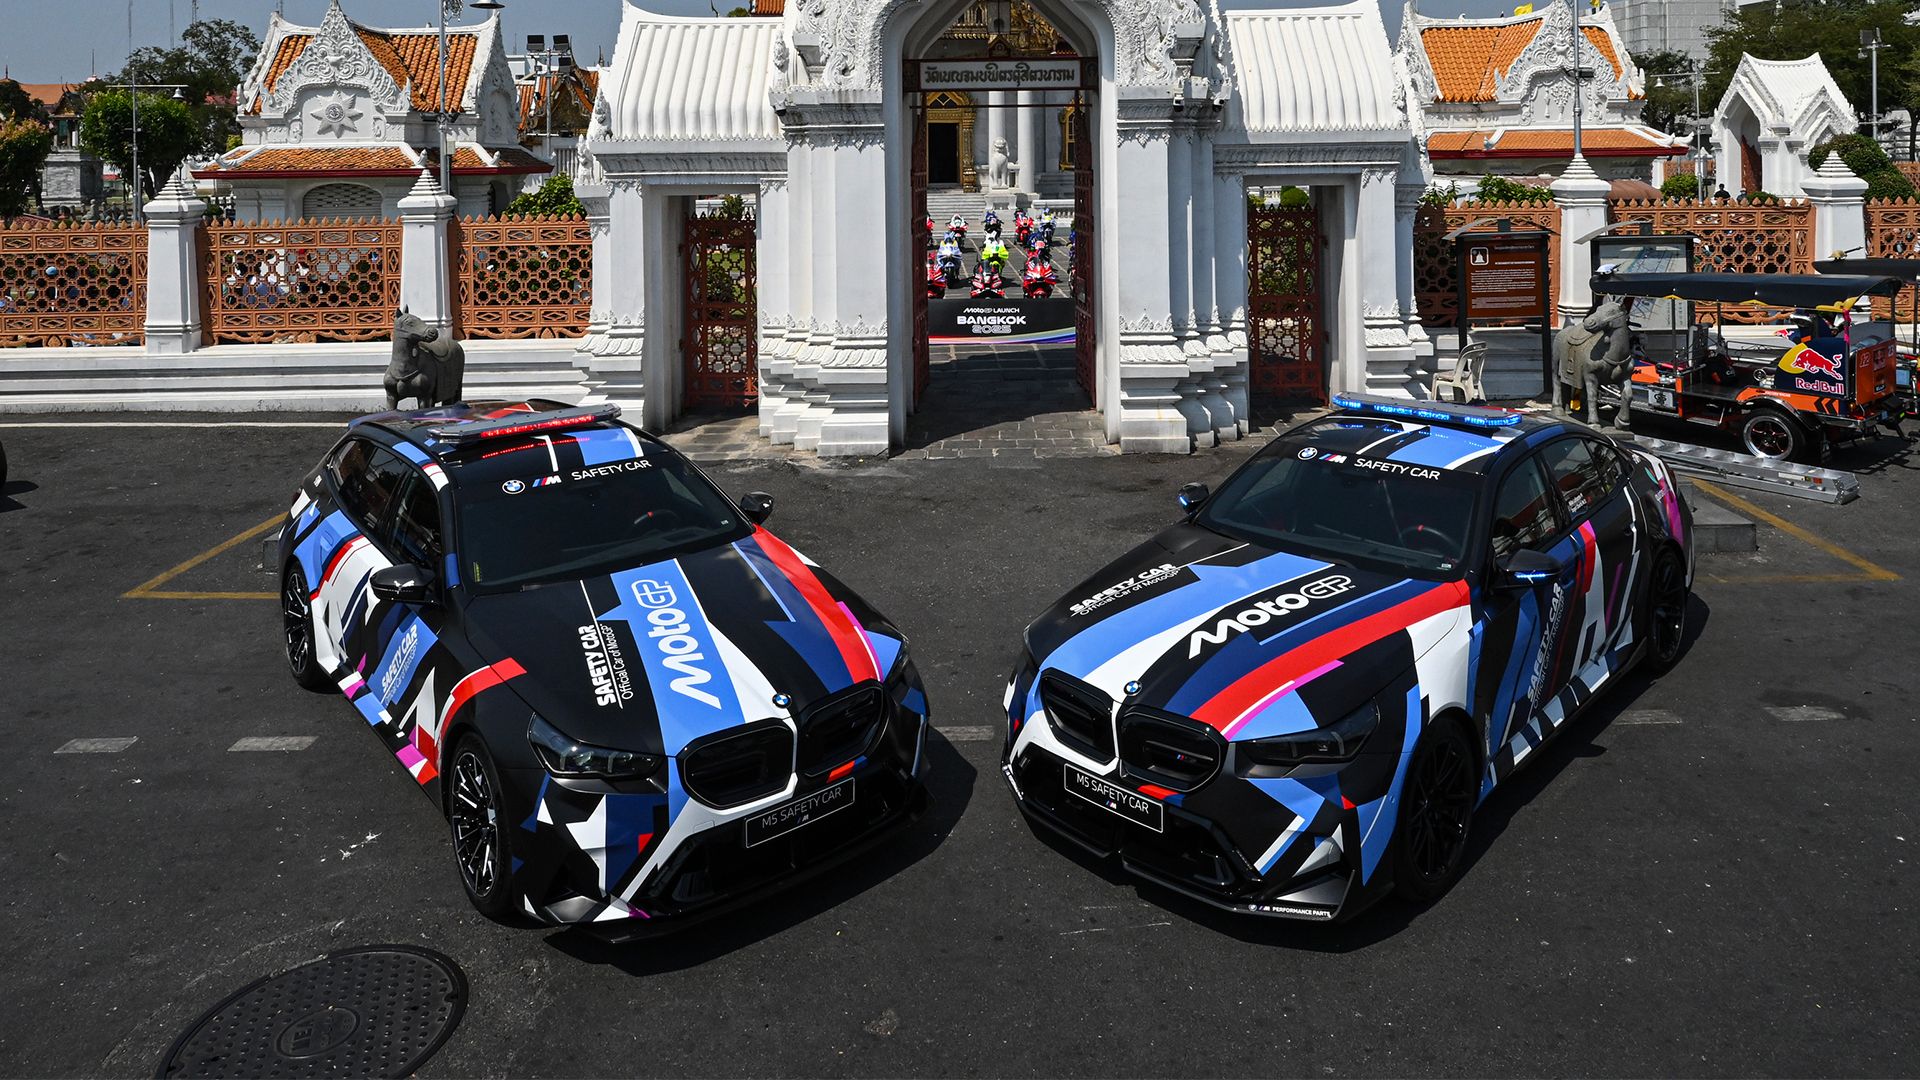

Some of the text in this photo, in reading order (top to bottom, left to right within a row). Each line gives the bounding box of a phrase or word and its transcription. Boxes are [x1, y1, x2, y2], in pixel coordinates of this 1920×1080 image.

[957, 315, 1027, 325] BANGKOK
[971, 324, 1012, 334] 2025
[1795, 377, 1845, 396] Red Bull
[570, 464, 624, 481] SAFETY
[625, 459, 652, 472] CAR
[1353, 458, 1410, 475] SAFETY
[1409, 467, 1441, 481] CAR
[1069, 563, 1177, 612] SAFETY CAR
[1115, 588, 1131, 599] Car
[1132, 582, 1143, 591] of
[1188, 575, 1353, 660] MotoGP
[608, 649, 621, 657] of
[631, 579, 722, 710] MotoGP
[1527, 582, 1562, 703] SAFETY CAR
[381, 624, 418, 693] SAFETY CAR
[578, 624, 617, 707] SAFETY CAR
[612, 656, 625, 670] Car
[615, 668, 634, 700] Official
[762, 786, 842, 828] M5 SAFETY CAR
[1076, 773, 1149, 814] M5 SAFETY CAR
[1272, 906, 1312, 915] PERFORMANCE
